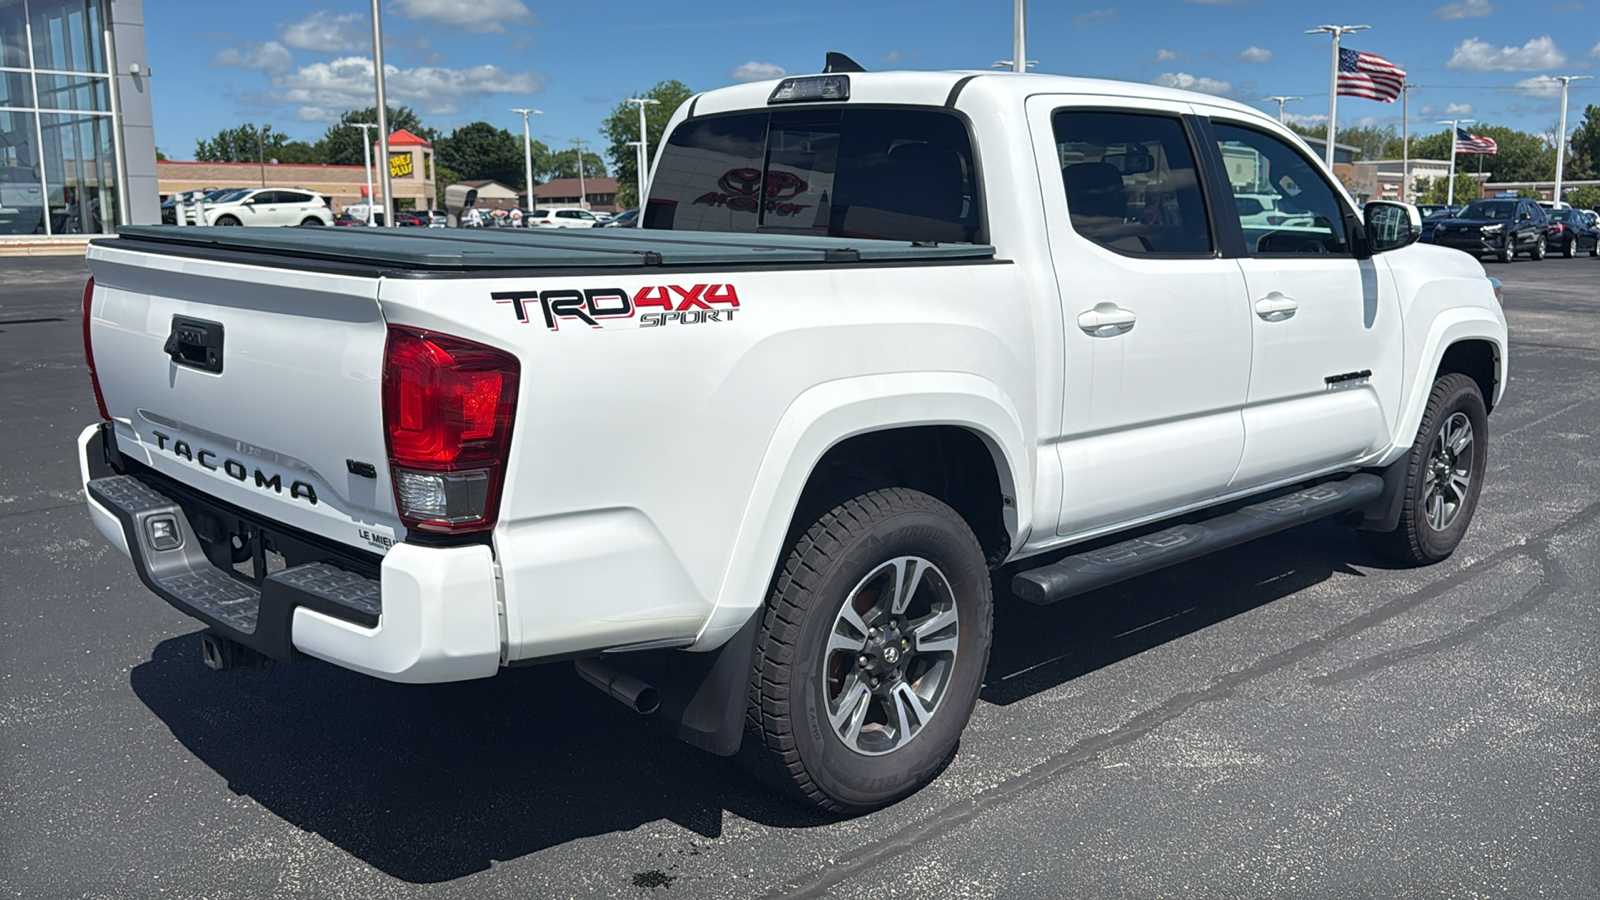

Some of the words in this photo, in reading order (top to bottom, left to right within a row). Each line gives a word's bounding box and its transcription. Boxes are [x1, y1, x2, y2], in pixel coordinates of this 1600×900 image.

[390, 163, 412, 178] PLUS
[490, 288, 635, 331] TRD
[639, 308, 740, 328] SPORT
[153, 430, 318, 505] TACOMA
[358, 529, 370, 541] LE
[371, 533, 398, 548] MIEU
